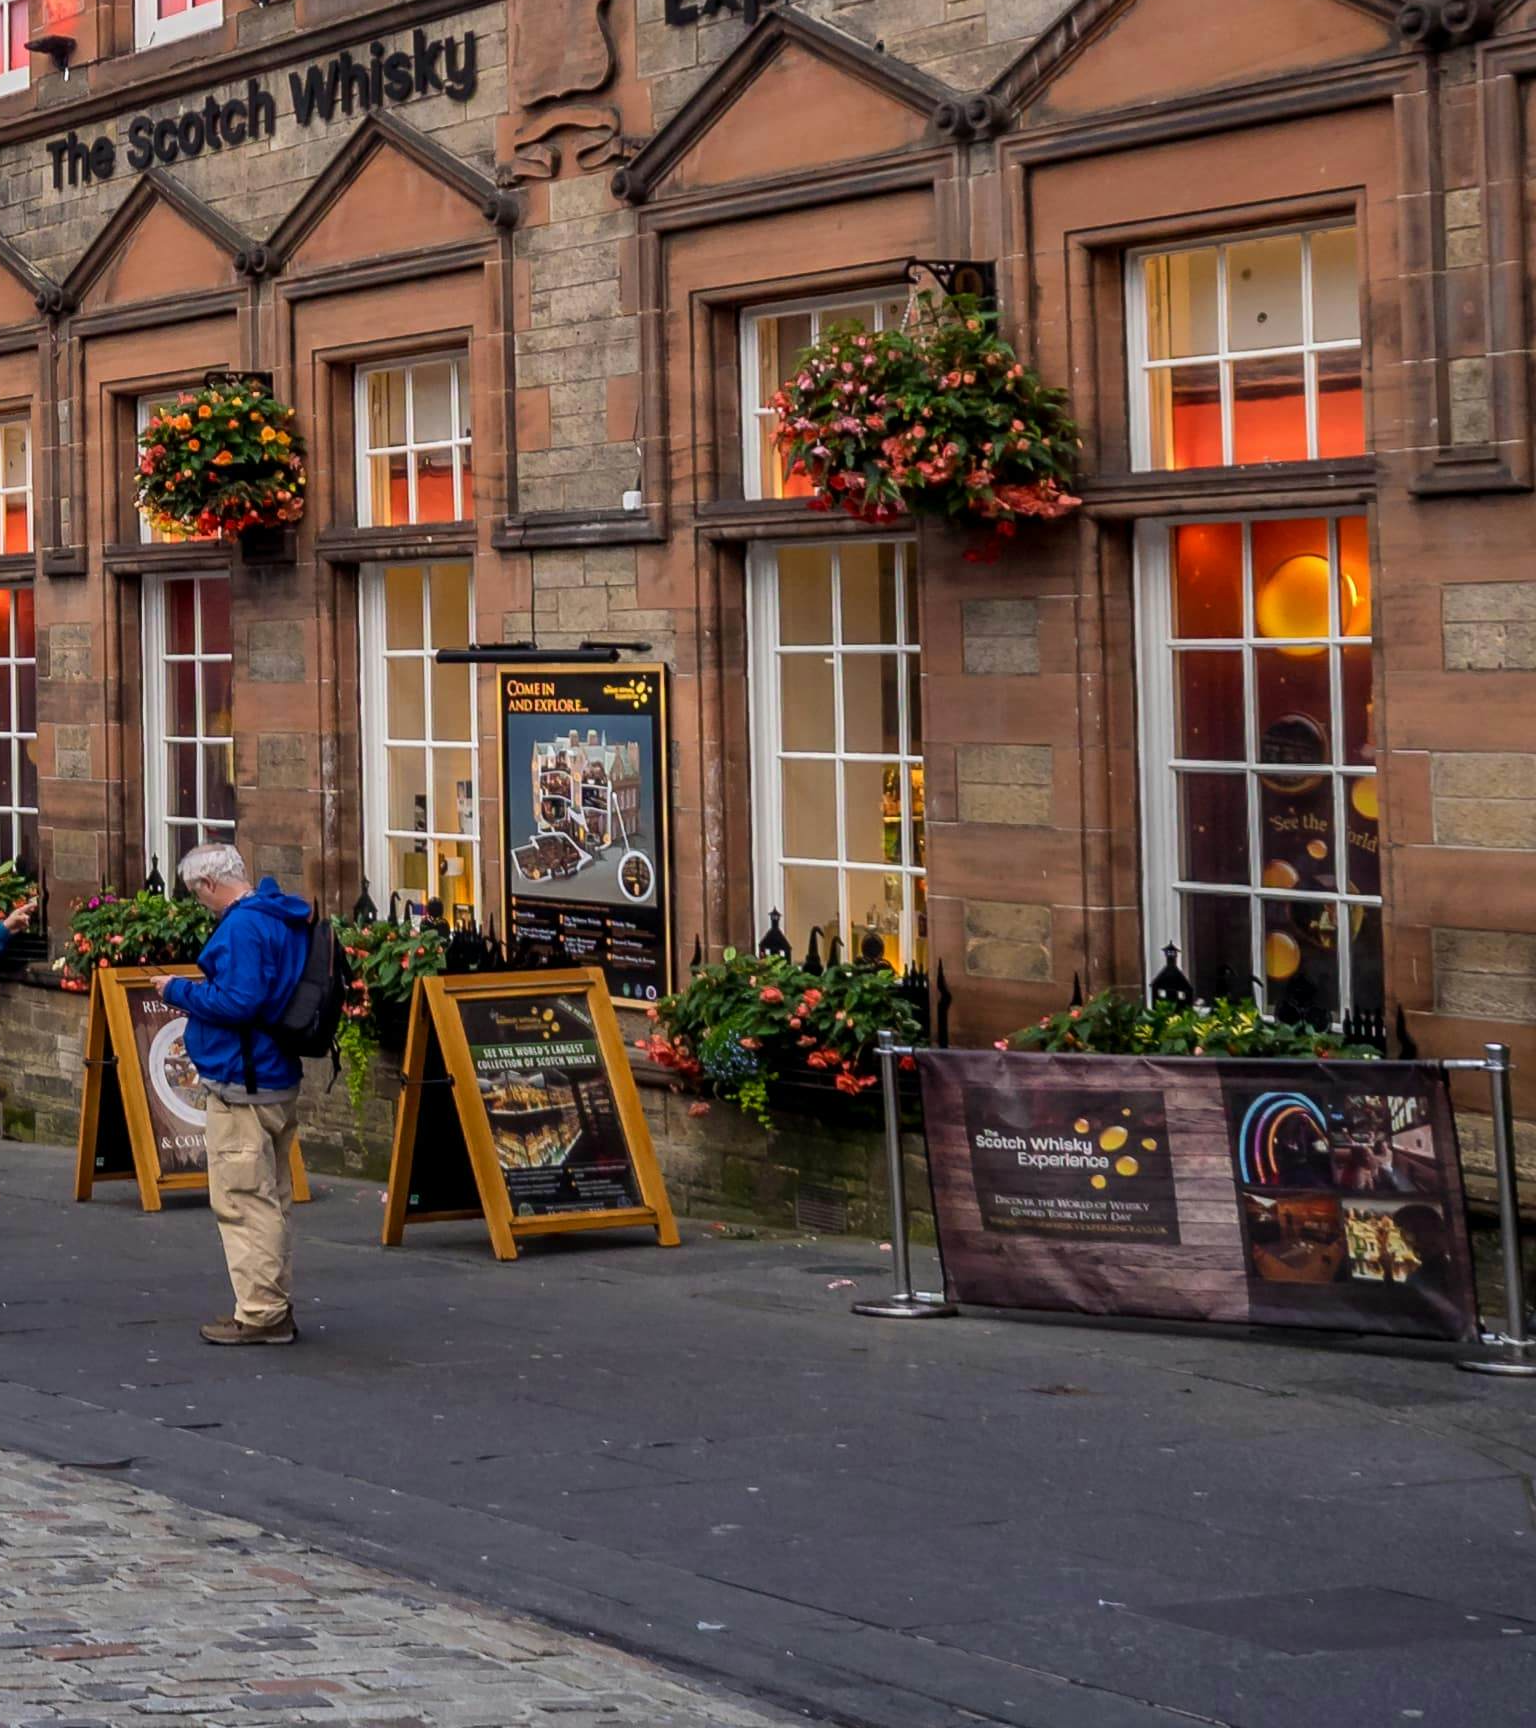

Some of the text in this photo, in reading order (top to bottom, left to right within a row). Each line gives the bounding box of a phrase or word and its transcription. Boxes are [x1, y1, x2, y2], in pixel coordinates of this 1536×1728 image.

[45, 131, 116, 190] The
[128, 80, 276, 172] Scotch
[288, 29, 477, 129] Whisky
[542, 682, 555, 696] IN
[1302, 812, 1328, 832] the
[1348, 824, 1378, 854] orld
[483, 1047, 497, 1059] SEE
[498, 1047, 514, 1058] THE
[551, 1043, 585, 1055] LARGEST
[477, 1054, 597, 1070] COLLECTION OF SCOTCH WHISKY
[983, 1128, 999, 1138] The
[161, 1136, 173, 1150] &
[975, 1135, 1093, 1155] Scotch Whisky
[1017, 1151, 1110, 1170] Experience
